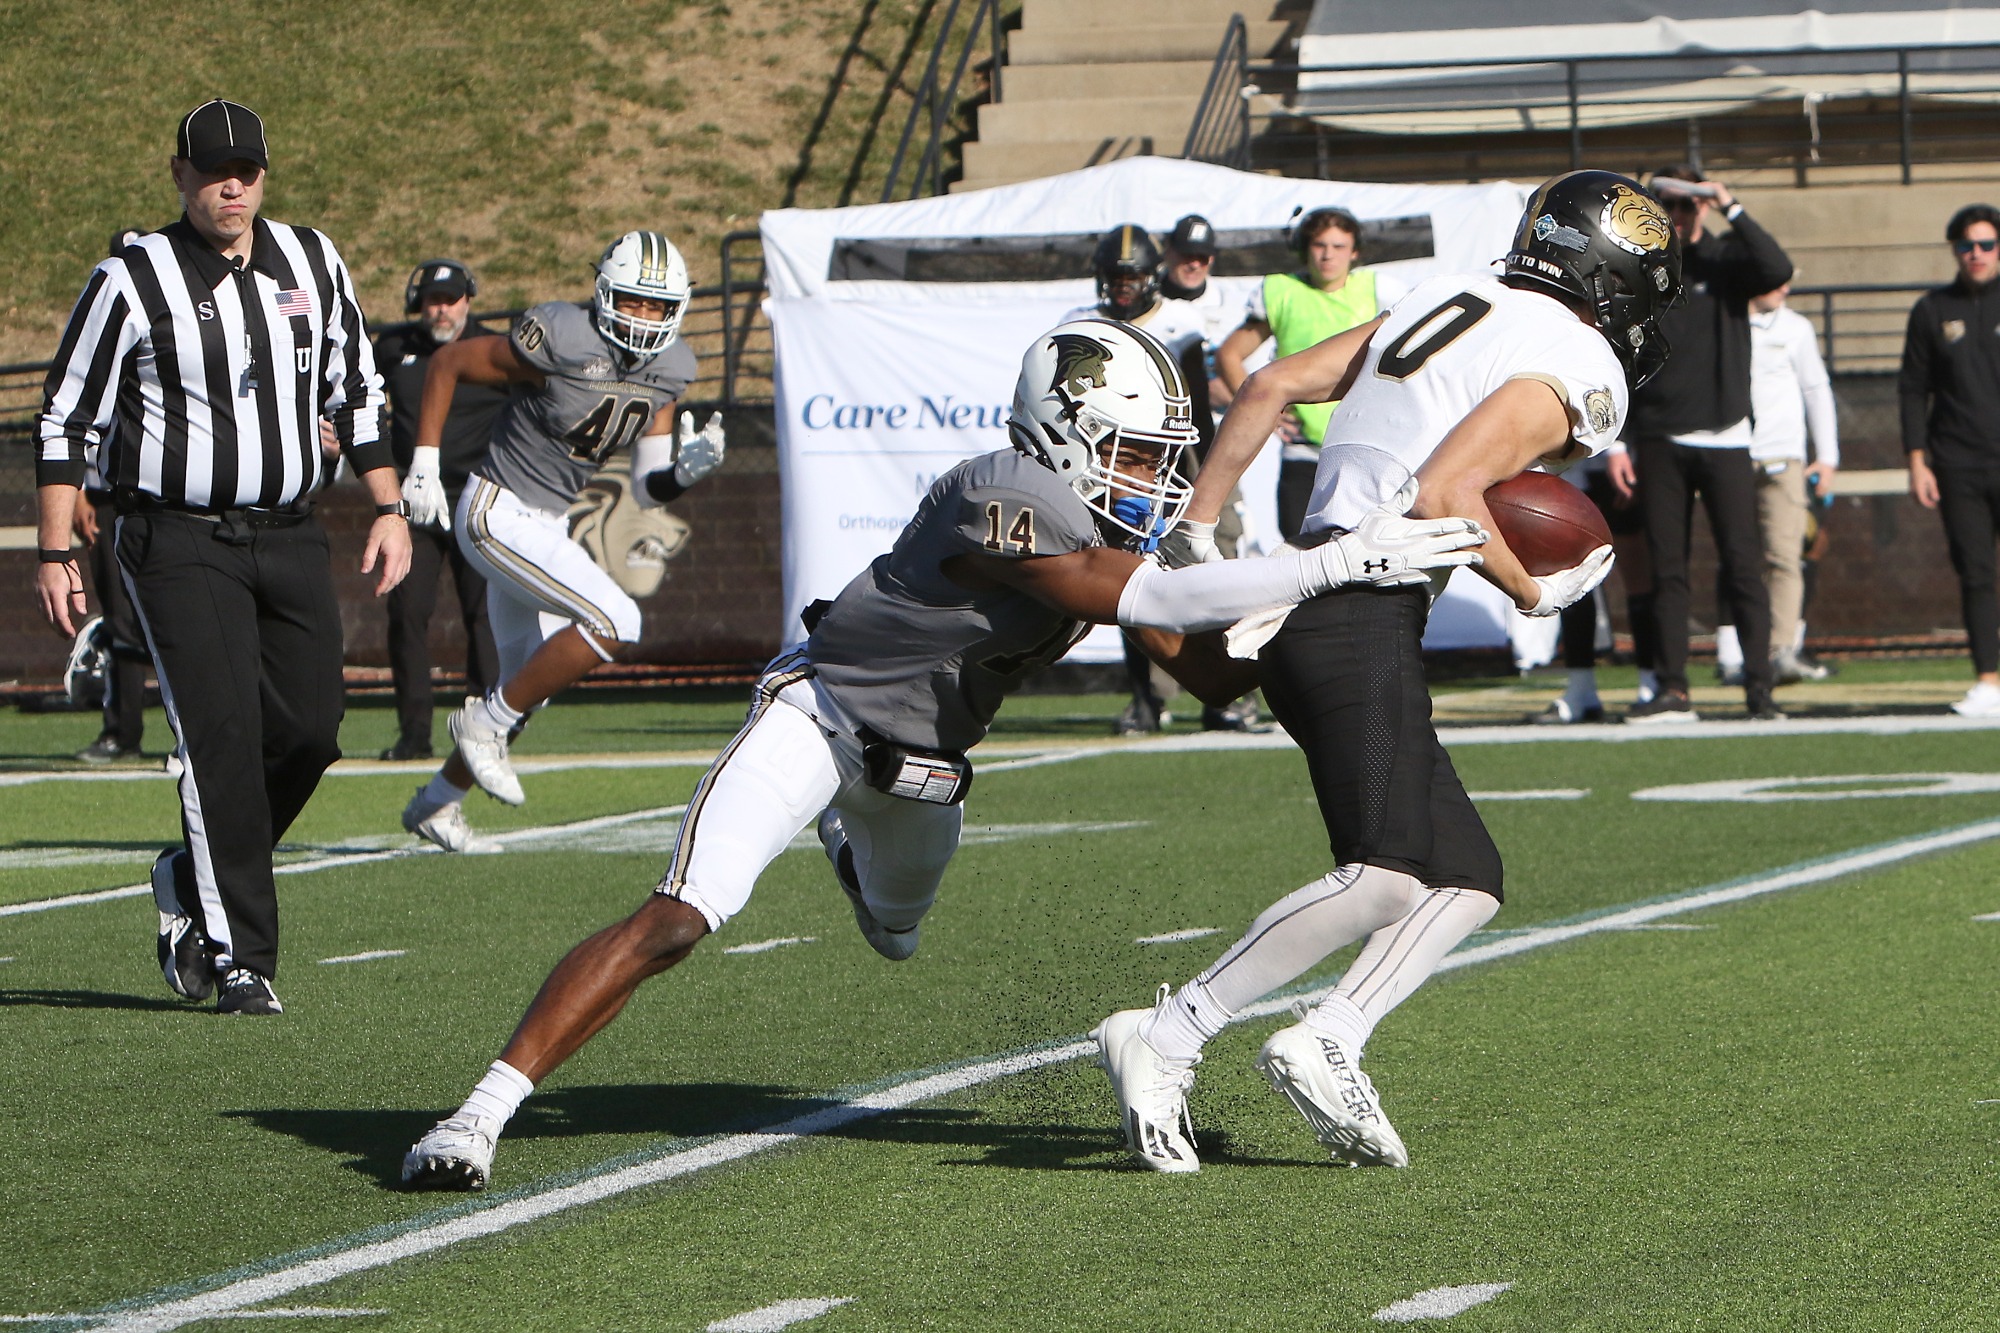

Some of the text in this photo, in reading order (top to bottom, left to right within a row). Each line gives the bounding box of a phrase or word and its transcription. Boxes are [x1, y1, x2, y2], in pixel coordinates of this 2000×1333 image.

[1521, 255, 1536, 267] TO
[1537, 260, 1563, 279] WIN
[198, 301, 215, 320] S
[517, 316, 545, 352] 40
[1373, 289, 1495, 383] 0
[296, 347, 311, 373] U
[802, 394, 906, 429] Care
[561, 394, 651, 466] 40
[984, 501, 1036, 555] 14
